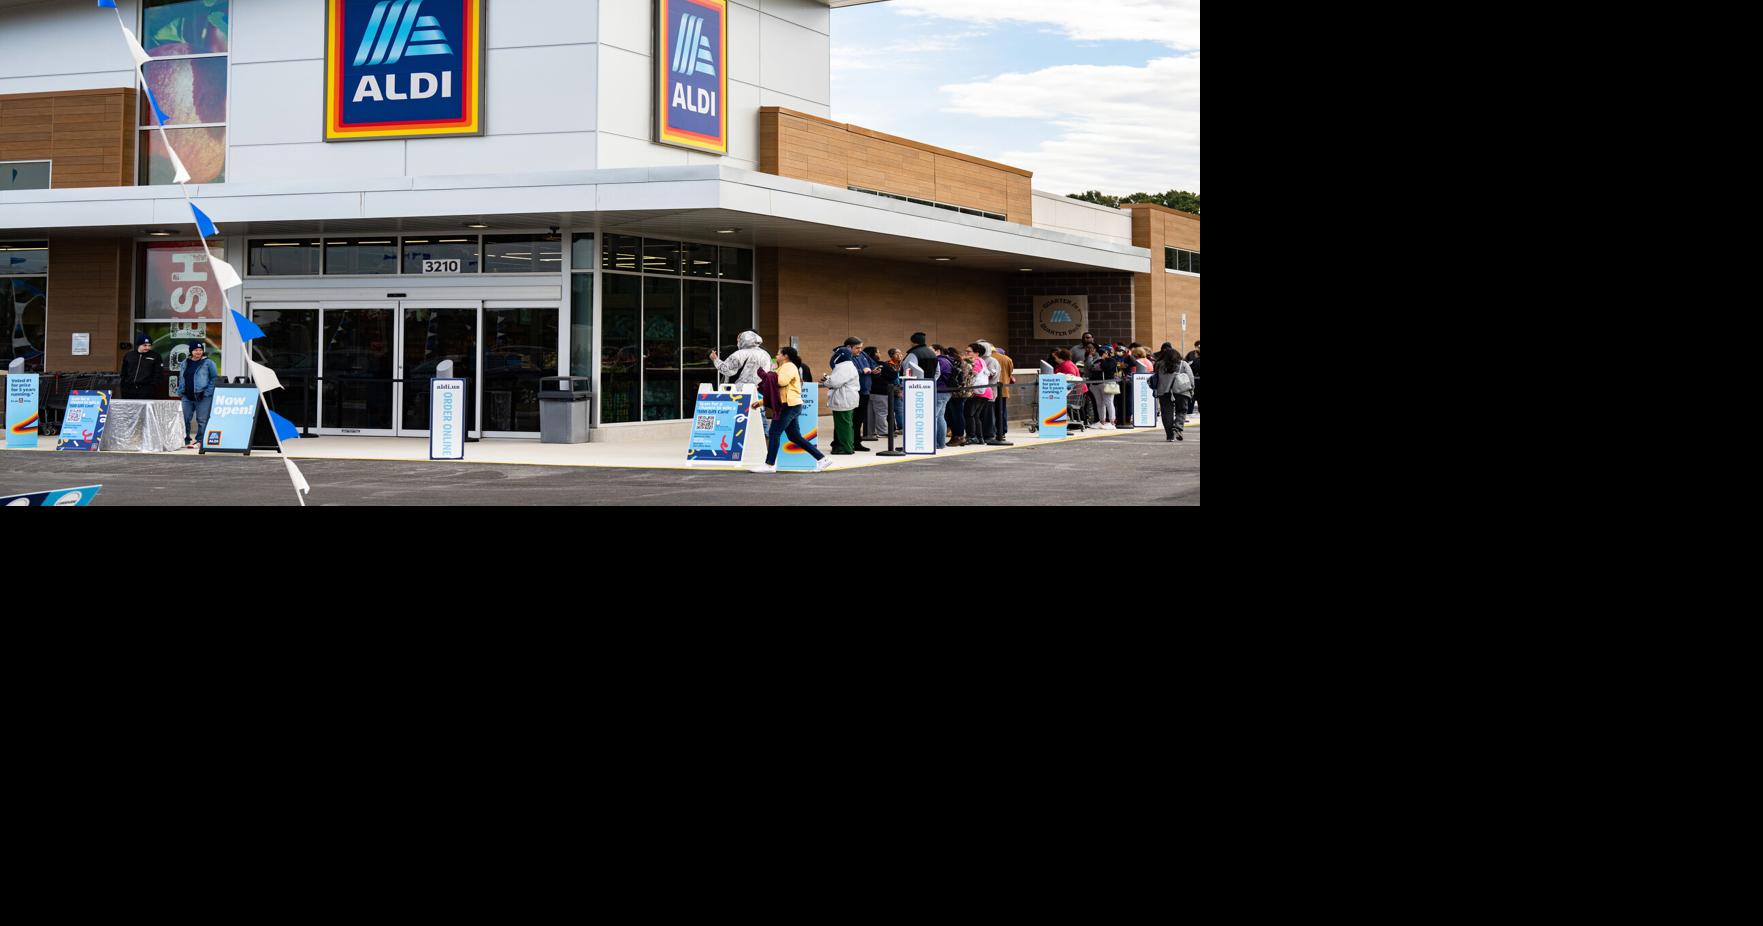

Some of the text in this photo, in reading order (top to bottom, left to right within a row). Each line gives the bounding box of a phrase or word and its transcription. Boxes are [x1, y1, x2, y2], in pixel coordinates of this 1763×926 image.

[352, 71, 452, 103] ALDI
[672, 82, 716, 117] ALDI
[425, 260, 458, 272] 3210
[169, 253, 208, 397] RESH
[214, 405, 254, 418] open!
[215, 395, 246, 406] Now
[442, 392, 453, 456] ORDER ONLINE
[915, 391, 924, 451] ORDER ONLINE
